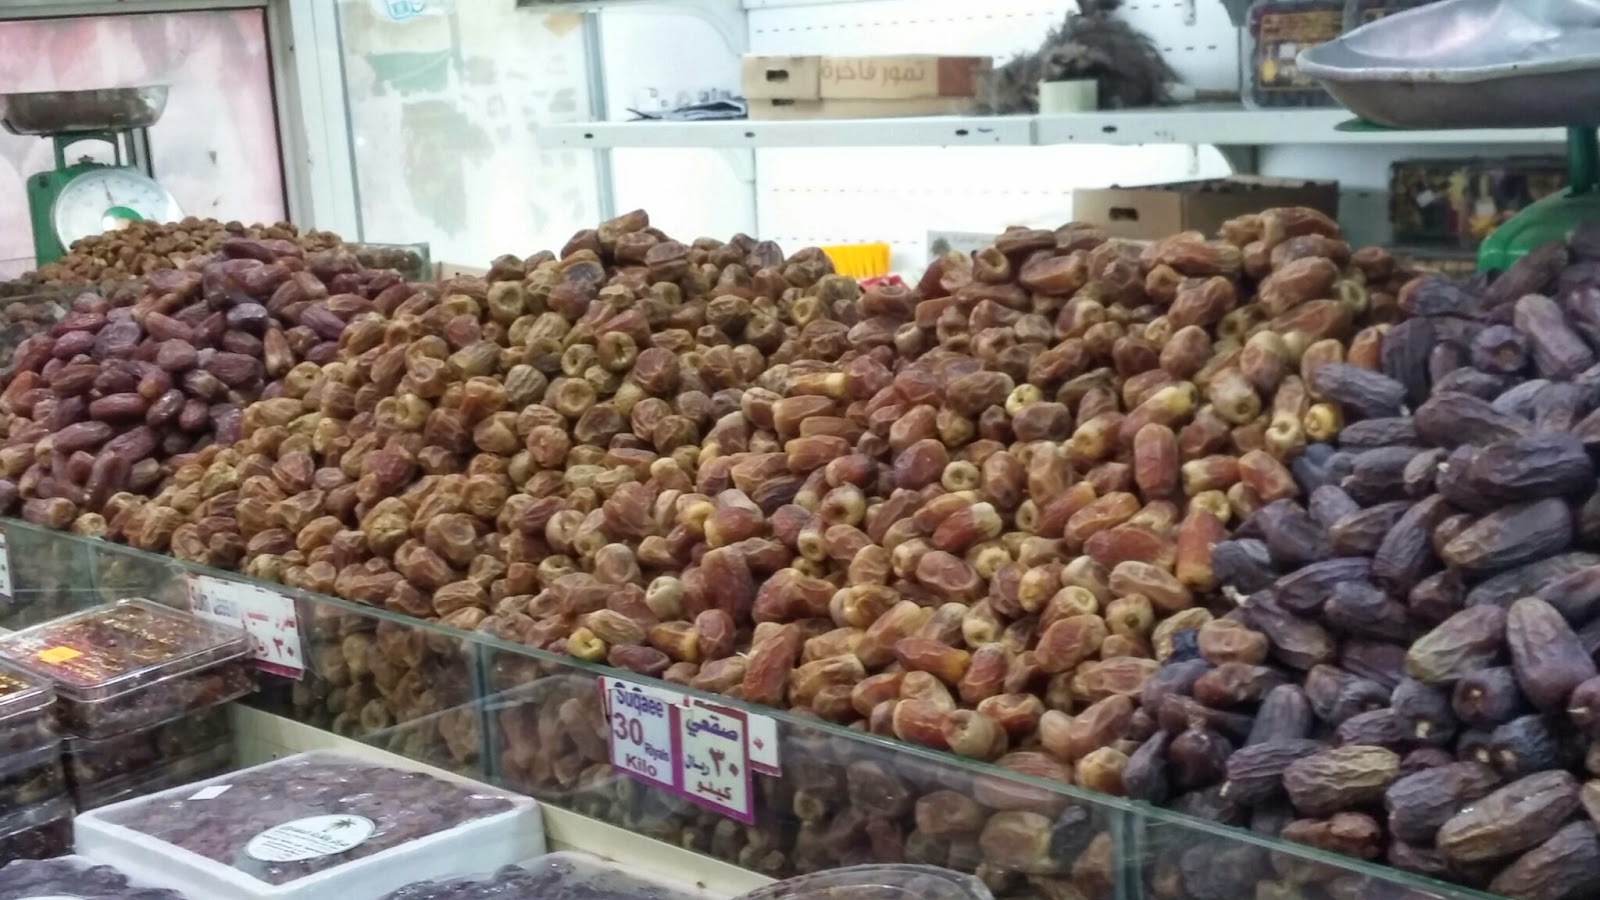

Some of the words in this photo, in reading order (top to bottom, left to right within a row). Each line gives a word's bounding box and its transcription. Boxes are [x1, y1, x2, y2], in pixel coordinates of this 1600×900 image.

[822, 58, 876, 86] فاخرة
[881, 60, 925, 87] تمور
[616, 689, 664, 718] Suqaee
[614, 712, 643, 746] 30
[625, 753, 658, 777] Kilo
[709, 747, 739, 777] ٣٠
[697, 781, 732, 801] كيلو
